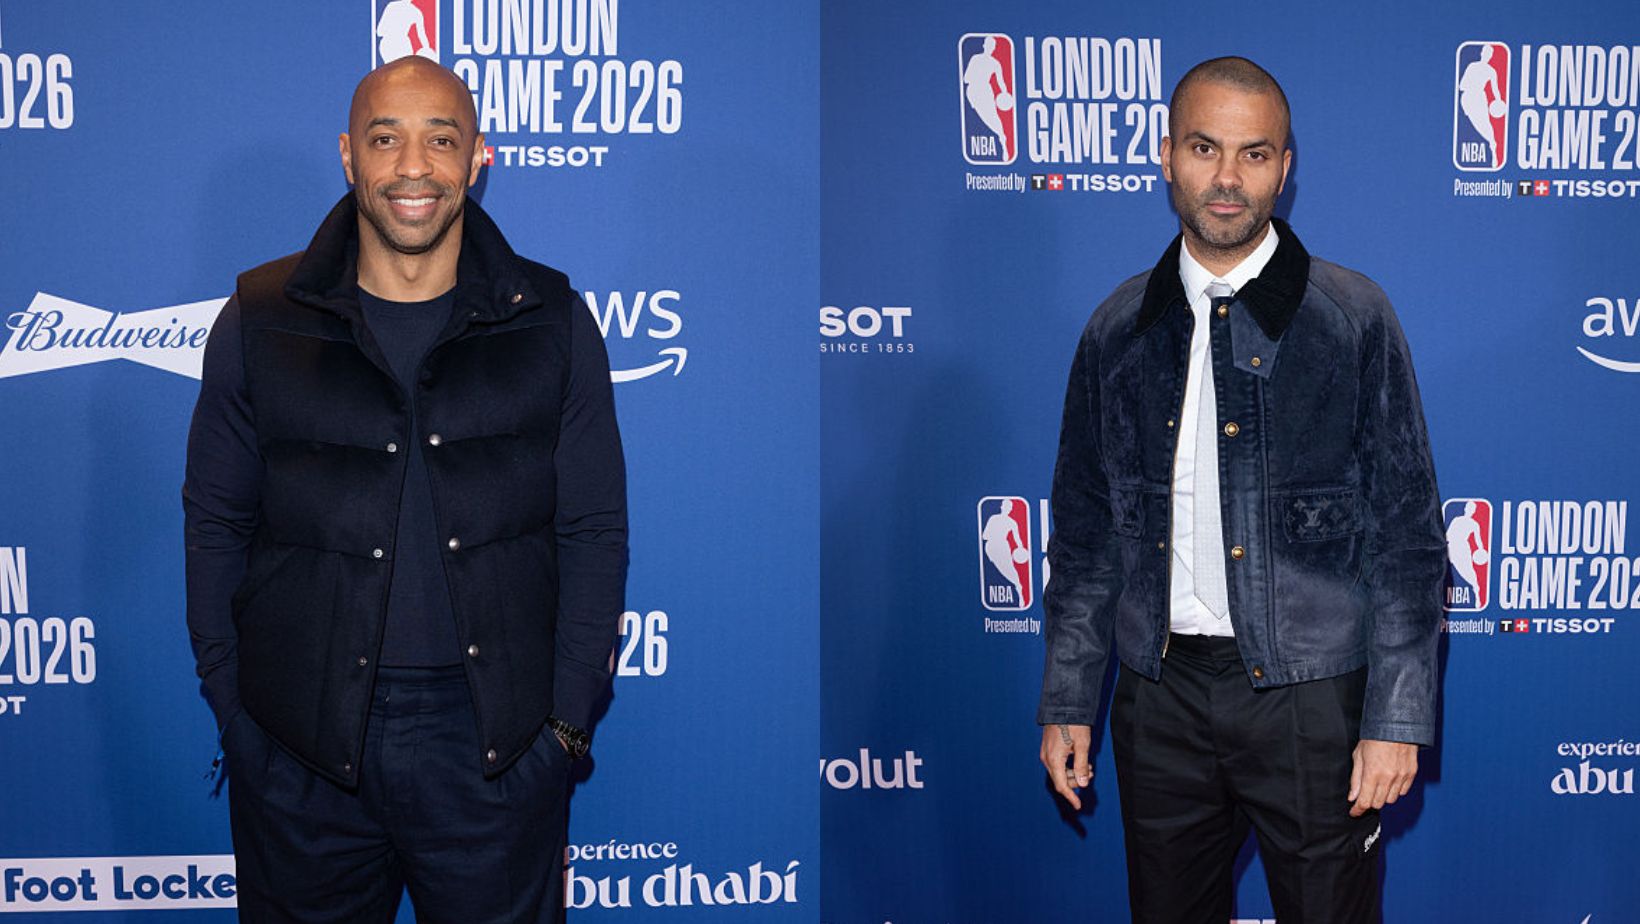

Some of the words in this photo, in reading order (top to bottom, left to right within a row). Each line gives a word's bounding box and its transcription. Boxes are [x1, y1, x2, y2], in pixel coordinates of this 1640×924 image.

[453, 0, 618, 55] LONDON
[1025, 36, 1162, 100] LONDON
[571, 60, 683, 134] 2026
[971, 136, 997, 156] NBA
[1027, 101, 1119, 164] GAME
[1125, 103, 1170, 165] 20
[1517, 109, 1608, 170] GAME
[1612, 110, 1640, 170] 2
[498, 146, 609, 167] TISSOT
[1461, 143, 1487, 163] NBA
[966, 172, 1012, 191] Presented
[1014, 173, 1026, 193] by
[1066, 174, 1157, 192] TISSOT
[1454, 179, 1500, 197] Presented
[1501, 180, 1513, 199] by
[1552, 180, 1640, 197] TISSOT
[820, 306, 912, 337] SOT
[820, 343, 868, 353] SINCE
[878, 343, 914, 353] 1853
[1501, 500, 1627, 555] LONDON
[989, 585, 1014, 603] NBA
[1447, 586, 1471, 604] NBA
[1499, 557, 1583, 610] GAME
[985, 617, 1029, 633] Presented
[1029, 617, 1041, 636] by
[1440, 618, 1484, 633] Presented
[1484, 618, 1496, 636] by
[1533, 618, 1615, 633] TISSOT
[617, 610, 668, 677] 26
[1551, 760, 1634, 794] abu
[4, 868, 98, 902] Foot
[112, 864, 237, 900] Locke
[563, 866, 632, 909] bu
